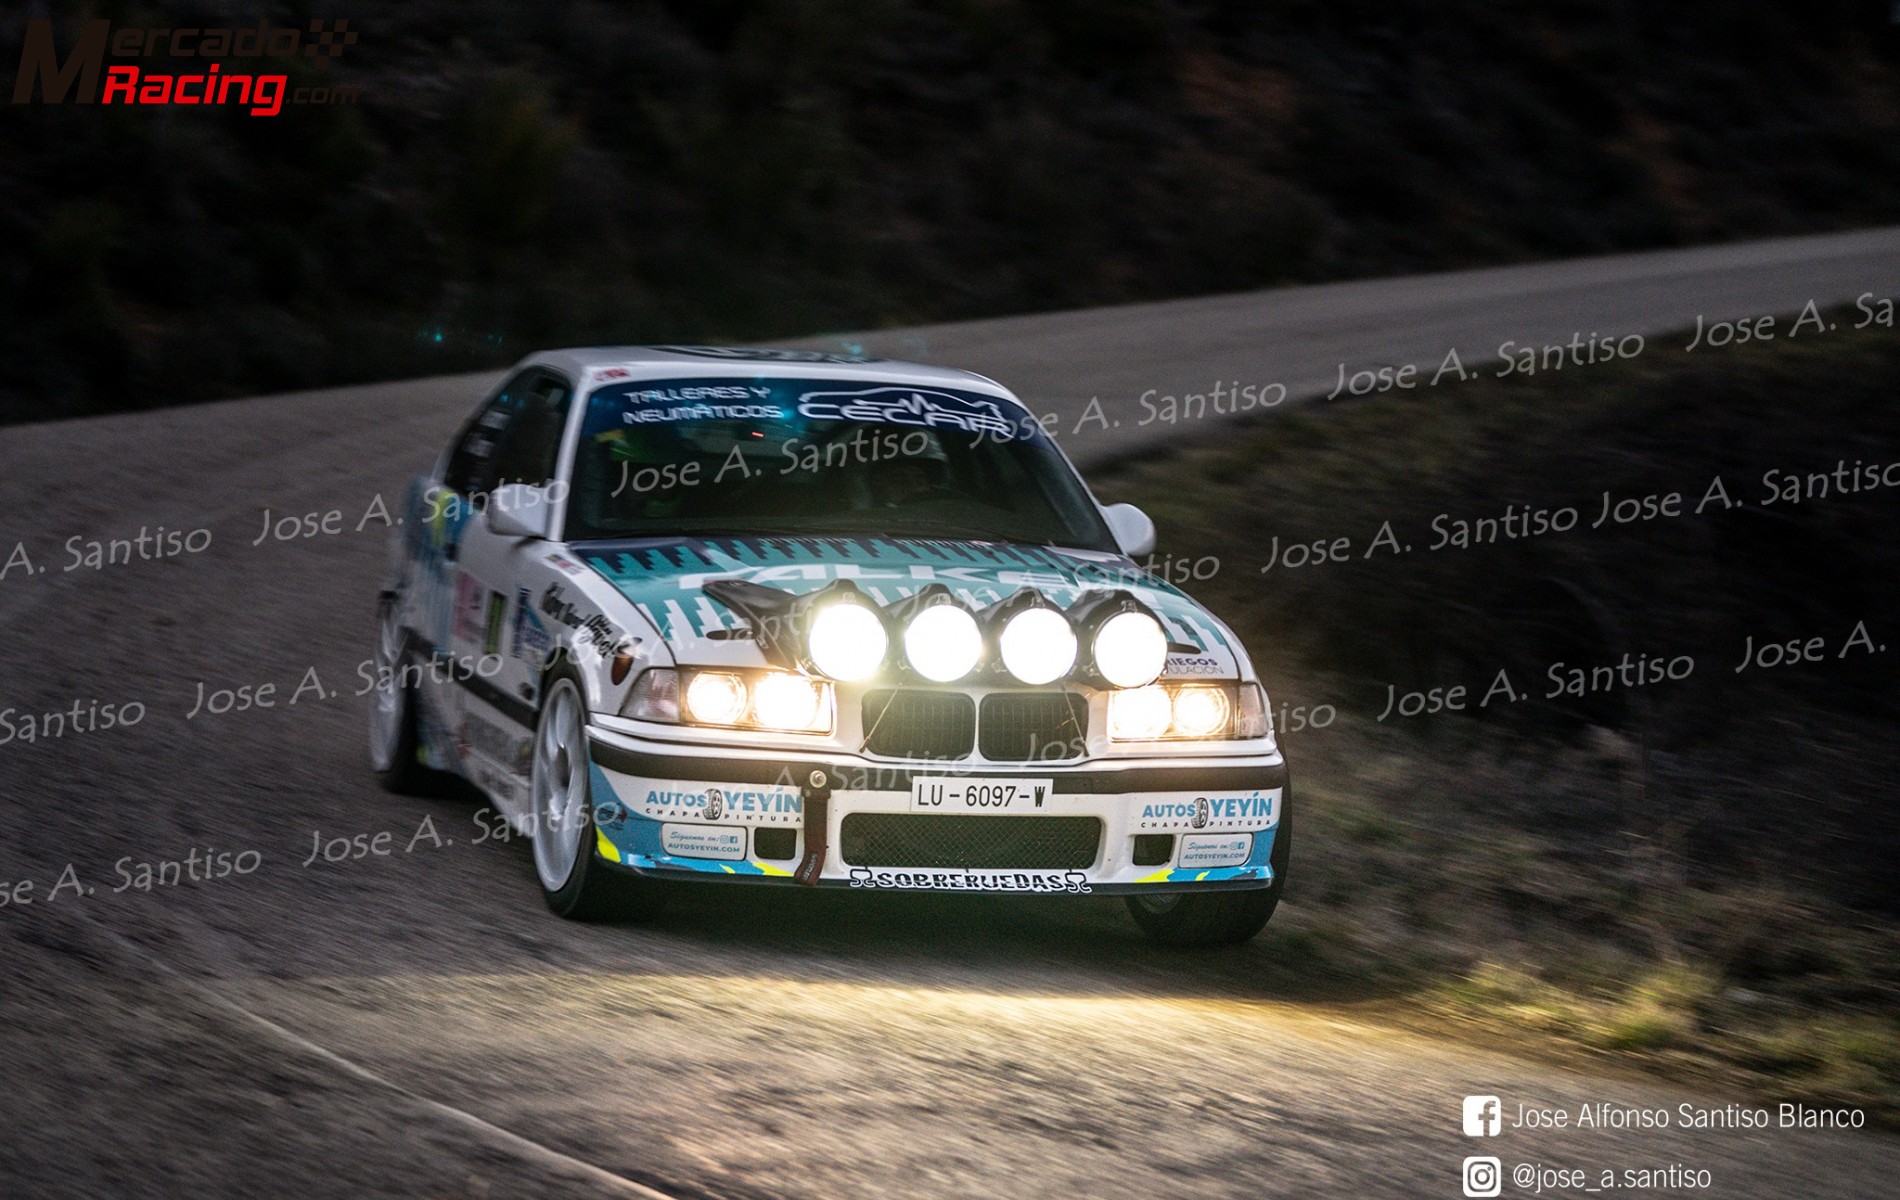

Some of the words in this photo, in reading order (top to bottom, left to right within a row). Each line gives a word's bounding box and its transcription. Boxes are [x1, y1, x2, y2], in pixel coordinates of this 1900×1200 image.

[622, 386, 750, 404] TALLERES
[750, 386, 771, 399] Y
[1168, 665, 1224, 675] ULACION
[645, 790, 708, 808] AUTOS
[723, 786, 802, 813] YEYÍN
[1142, 804, 1196, 818] AUTOS
[1209, 792, 1273, 818] YEYÍN
[645, 807, 700, 818] CHAPA
[724, 813, 802, 823] PINTURA
[1141, 821, 1189, 829] CHAPA
[1209, 819, 1271, 828] PINTURA
[667, 842, 740, 853] AUTOSYEYIN.COM
[876, 872, 1067, 893] SOBRERUEDAS
